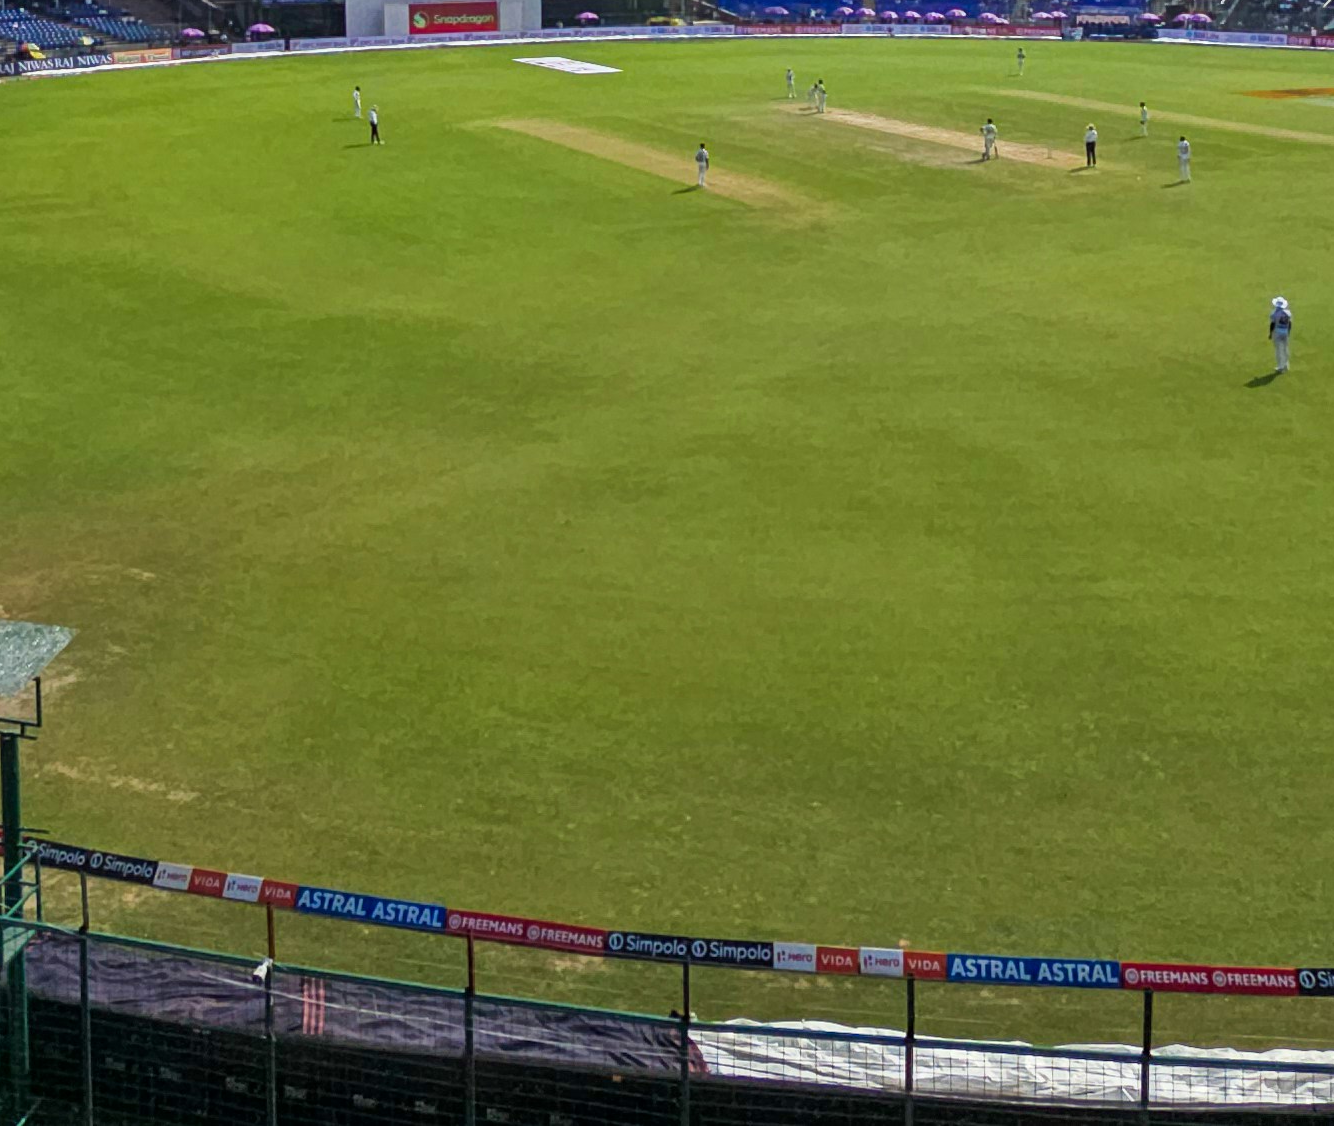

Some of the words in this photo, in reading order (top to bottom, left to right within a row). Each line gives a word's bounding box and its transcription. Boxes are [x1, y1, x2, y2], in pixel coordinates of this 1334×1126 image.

[433, 13, 494, 26] Snapdragon
[18, 59, 54, 73] NIWAS
[54, 57, 74, 70] RAJ
[77, 54, 113, 68] NIWAS
[38, 842, 85, 867] Simpolo
[105, 855, 153, 880] Simpolo
[194, 875, 221, 890] VIDA
[265, 886, 292, 901] VIDA
[298, 890, 366, 917] ASTRAL
[371, 901, 442, 928] ASTRAL
[462, 917, 524, 937] FREEMANS
[540, 927, 603, 948] FREEMANS
[627, 935, 687, 957] Simpolo
[709, 941, 771, 962] Simpolo
[820, 954, 853, 967] VIDA
[908, 959, 940, 972] VIDA
[951, 957, 1032, 981] ASTRAL
[1038, 962, 1119, 984] ASTRAL
[1140, 968, 1208, 986] FREEMANS
[1226, 972, 1296, 989] FREEMANS
